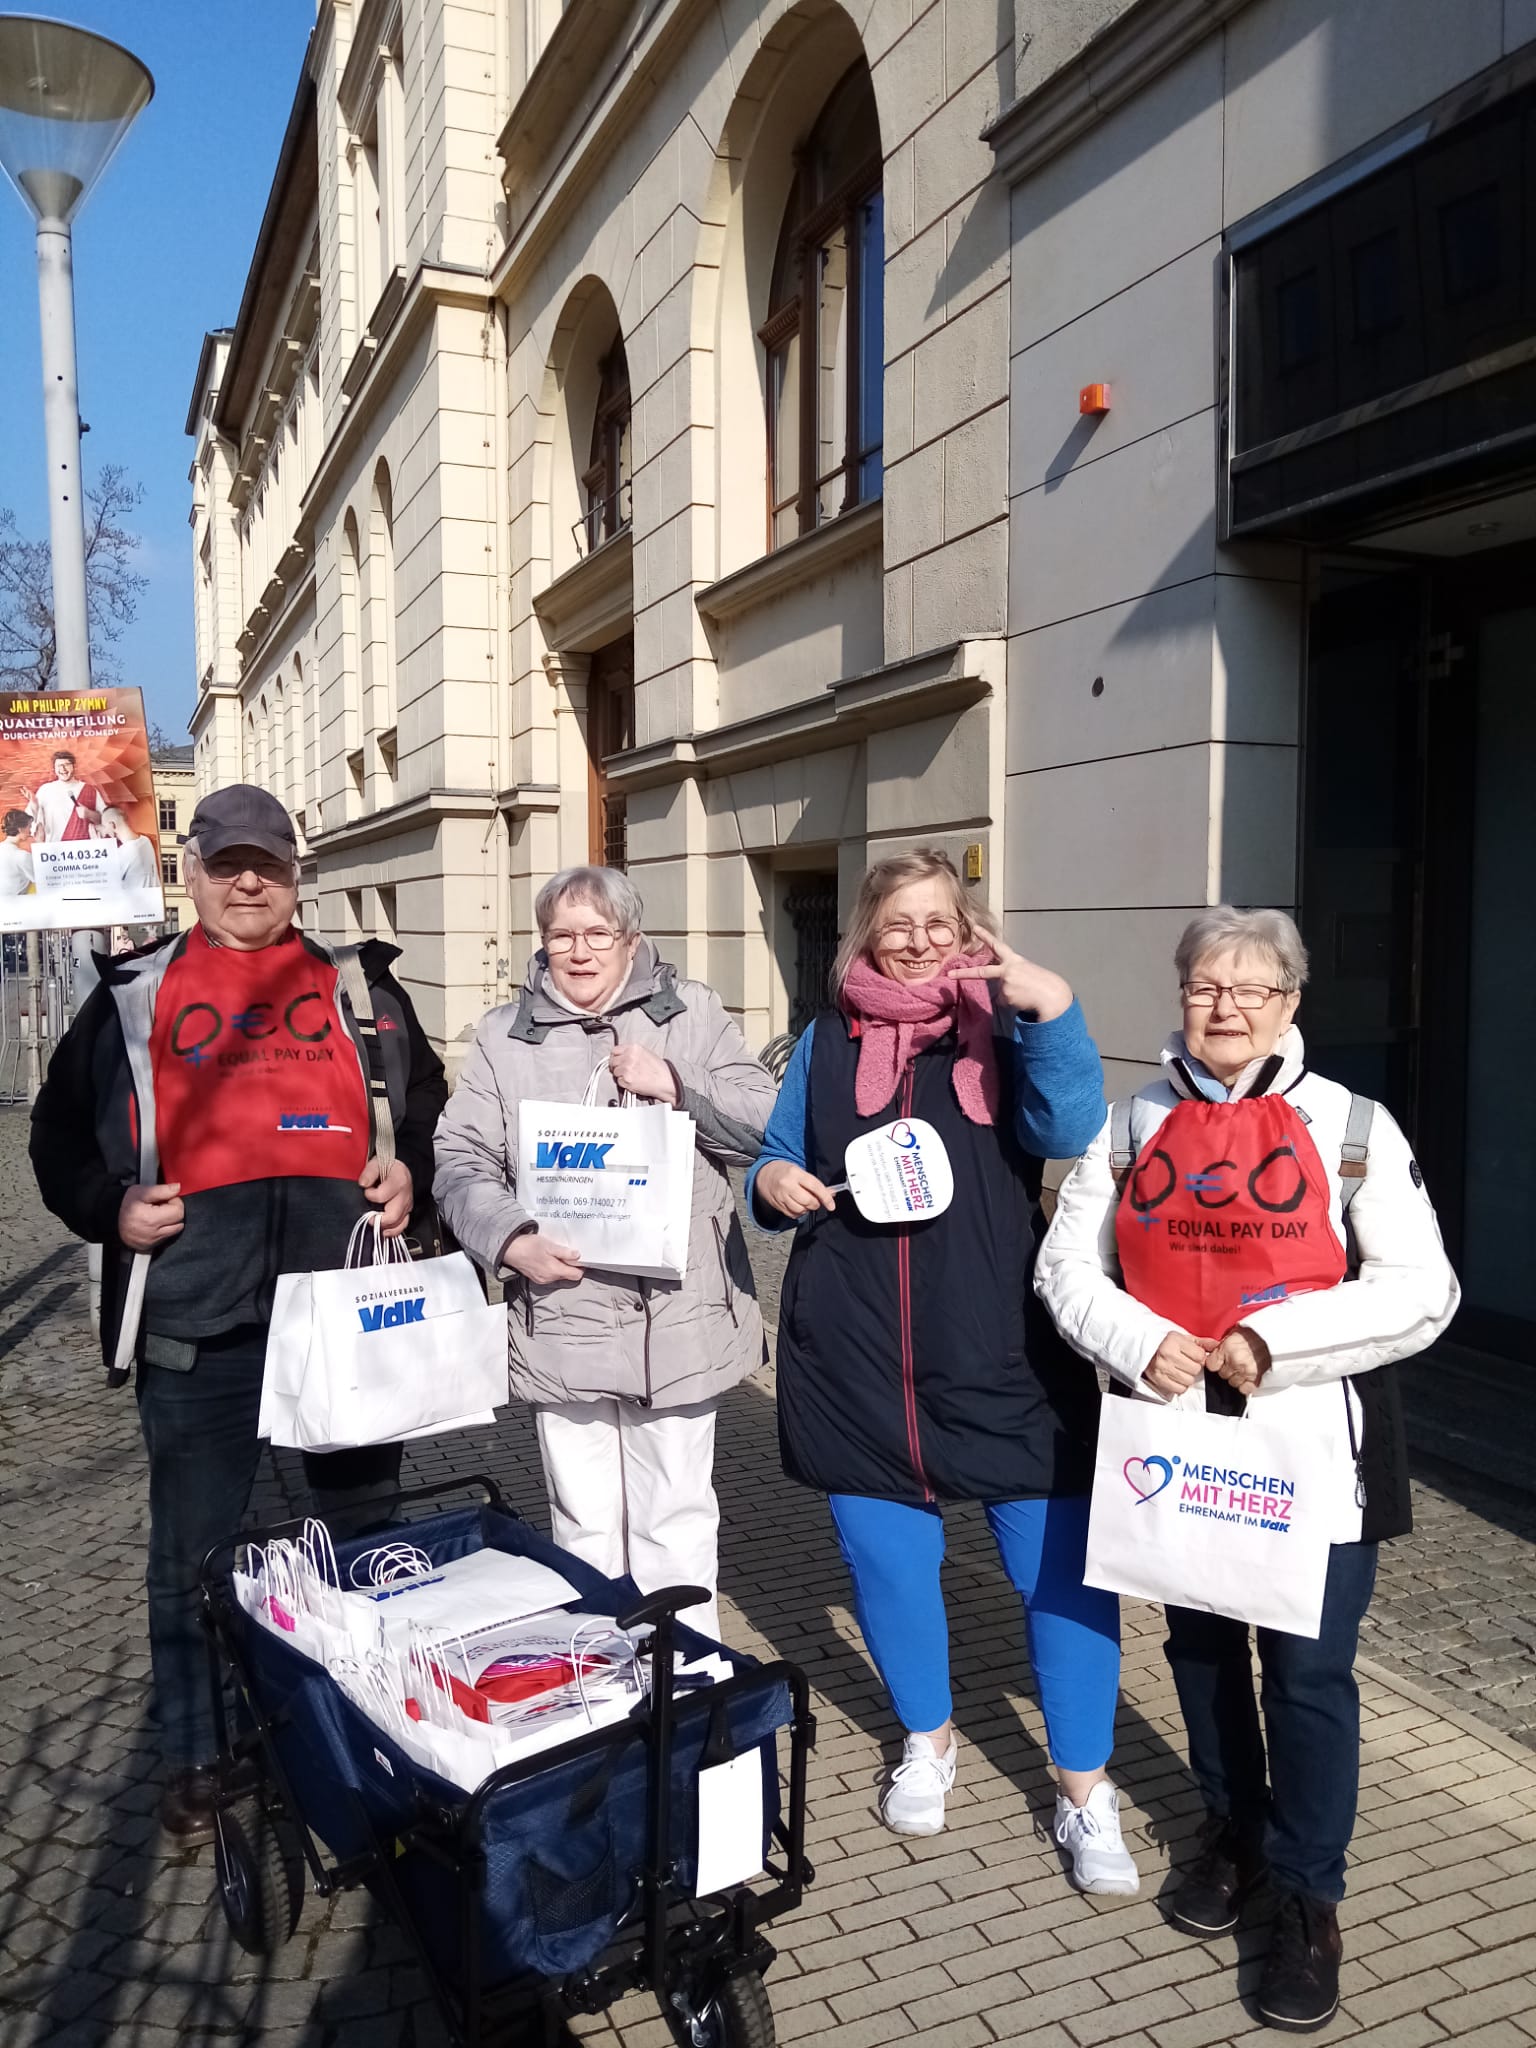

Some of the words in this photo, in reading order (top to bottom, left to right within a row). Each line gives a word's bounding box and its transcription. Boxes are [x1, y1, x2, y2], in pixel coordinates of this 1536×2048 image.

[10, 700, 30, 713] JAN
[33, 699, 71, 712] PHILIPP
[74, 697, 108, 711] ZYMNY
[3, 732, 36, 740] DURCH
[38, 731, 67, 739] STAND
[40, 849, 108, 862] Do.14.03.24
[52, 864, 80, 872] COMMA
[218, 1049, 268, 1066] EQUAL
[276, 1048, 300, 1060] PAY
[306, 1049, 334, 1061] DAY
[280, 1114, 329, 1128] VdK
[538, 1130, 619, 1138] SOZIALVERBAND
[536, 1142, 615, 1168] VdK
[900, 1155, 916, 1174] MIT
[912, 1152, 934, 1208] MENSCHEN
[907, 1179, 924, 1210] HERZ
[1168, 1220, 1225, 1236] EQUAL
[1232, 1222, 1264, 1238] PAY
[1271, 1222, 1308, 1238] DAY
[1169, 1242, 1185, 1251] Wir
[1188, 1243, 1207, 1252] sind
[1210, 1243, 1240, 1254] dabei!
[355, 1286, 424, 1303] SOZIALVERBAND
[358, 1298, 426, 1332] VdK
[1182, 1463, 1295, 1496] MENSCHEN
[1180, 1482, 1222, 1504] MIT
[1229, 1490, 1293, 1520] HERZ
[1179, 1504, 1242, 1524] EHRENAMT
[1244, 1516, 1258, 1526] IM
[1260, 1519, 1290, 1532] VdK
